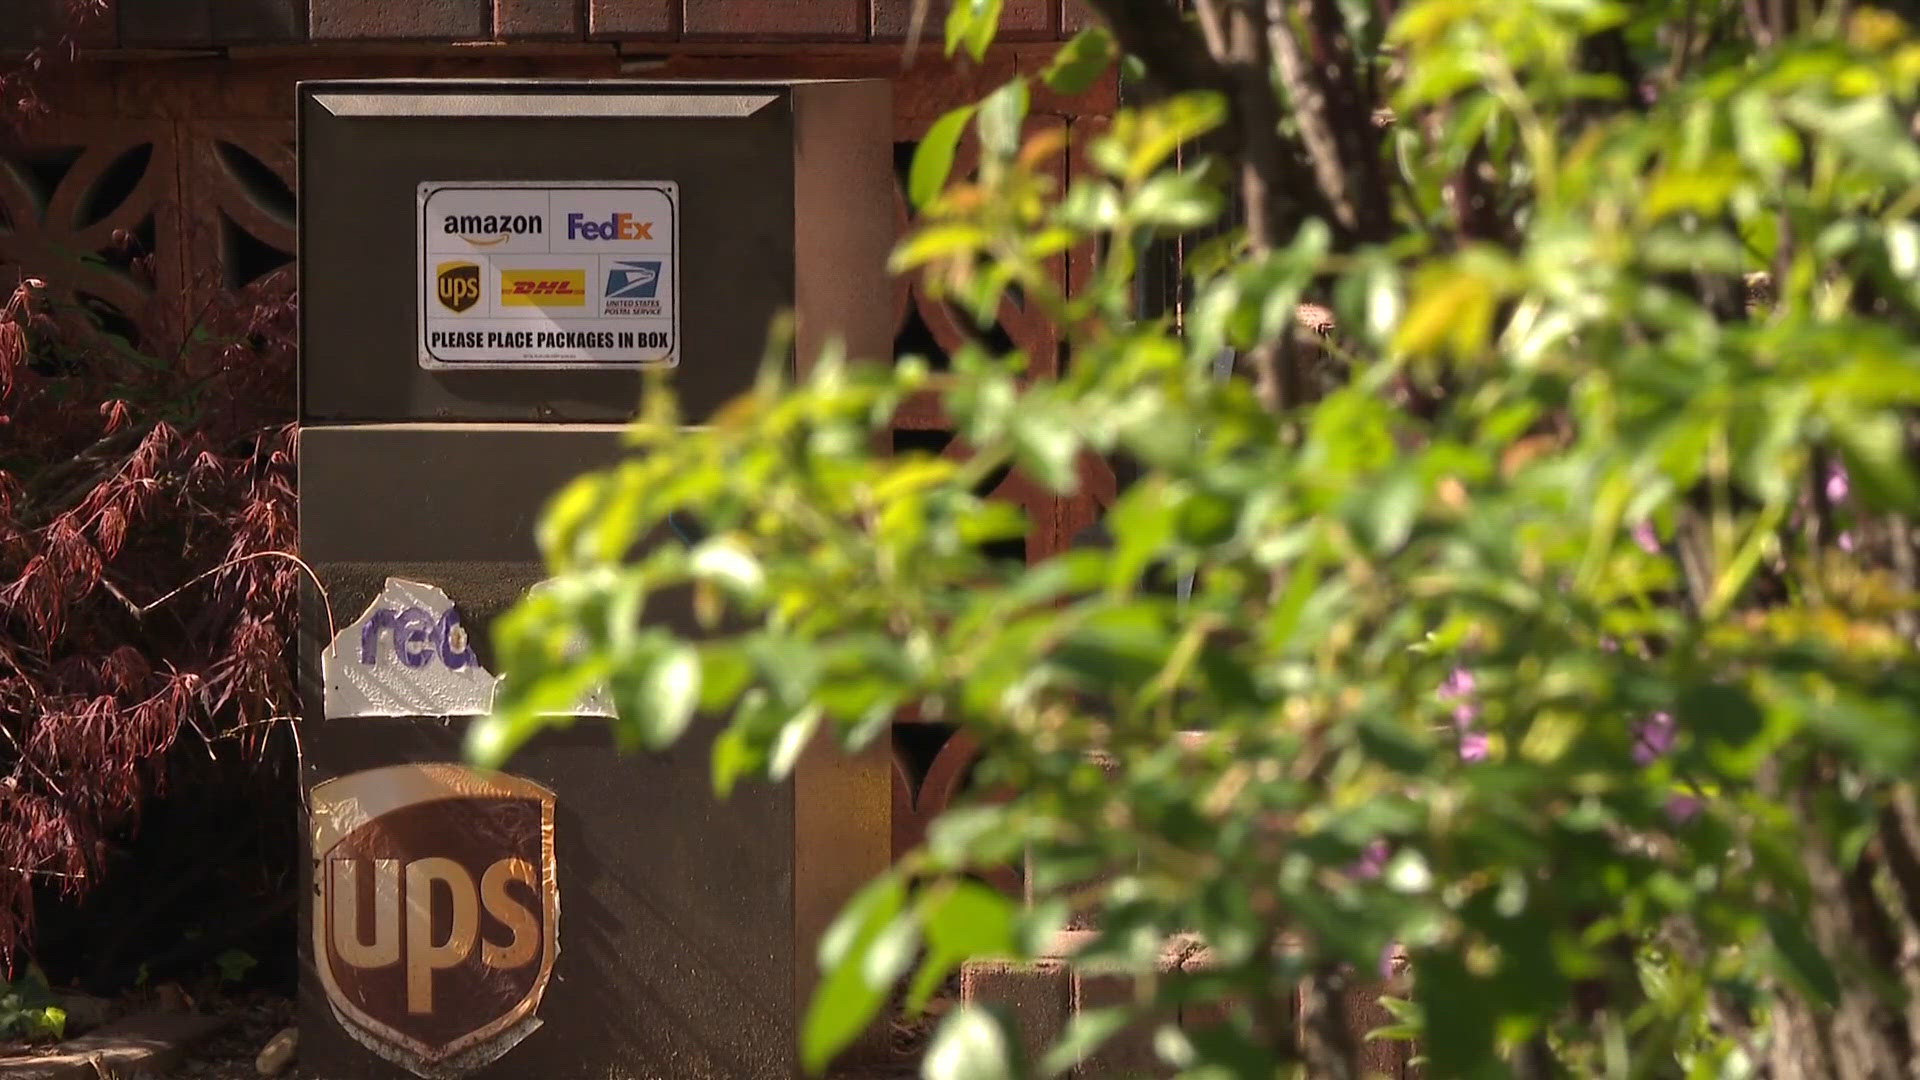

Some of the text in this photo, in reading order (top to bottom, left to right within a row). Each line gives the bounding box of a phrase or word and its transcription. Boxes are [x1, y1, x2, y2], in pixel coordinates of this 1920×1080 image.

[444, 214, 542, 234] amazon
[567, 212, 653, 240] FedEx
[439, 277, 478, 306] ups
[513, 281, 573, 295] DHL
[432, 332, 668, 348] PLEASE PLACE PACKAGES IN BOX
[332, 857, 540, 1014] ups
